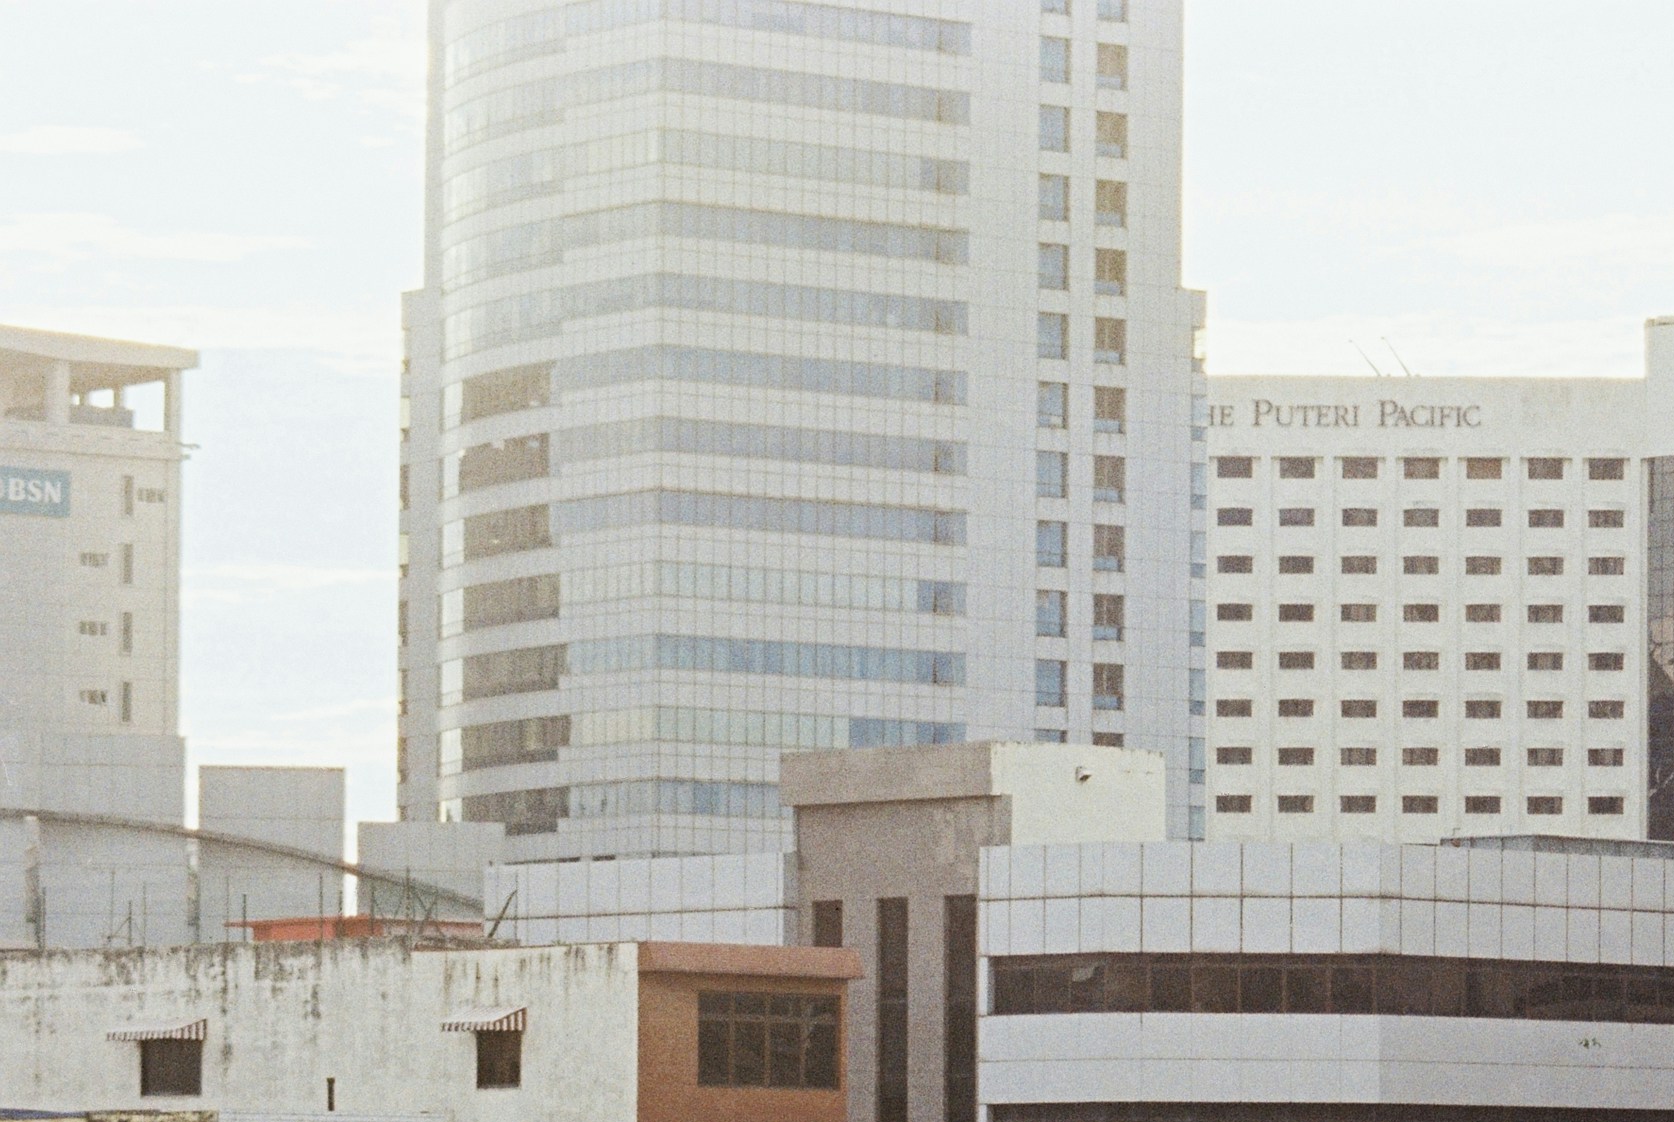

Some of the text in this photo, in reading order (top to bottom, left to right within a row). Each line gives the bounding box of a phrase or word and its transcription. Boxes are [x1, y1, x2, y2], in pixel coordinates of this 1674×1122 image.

[1252, 400, 1361, 427] PUTERI
[1378, 400, 1481, 427] PACIFIC
[9, 478, 61, 503] BSN
